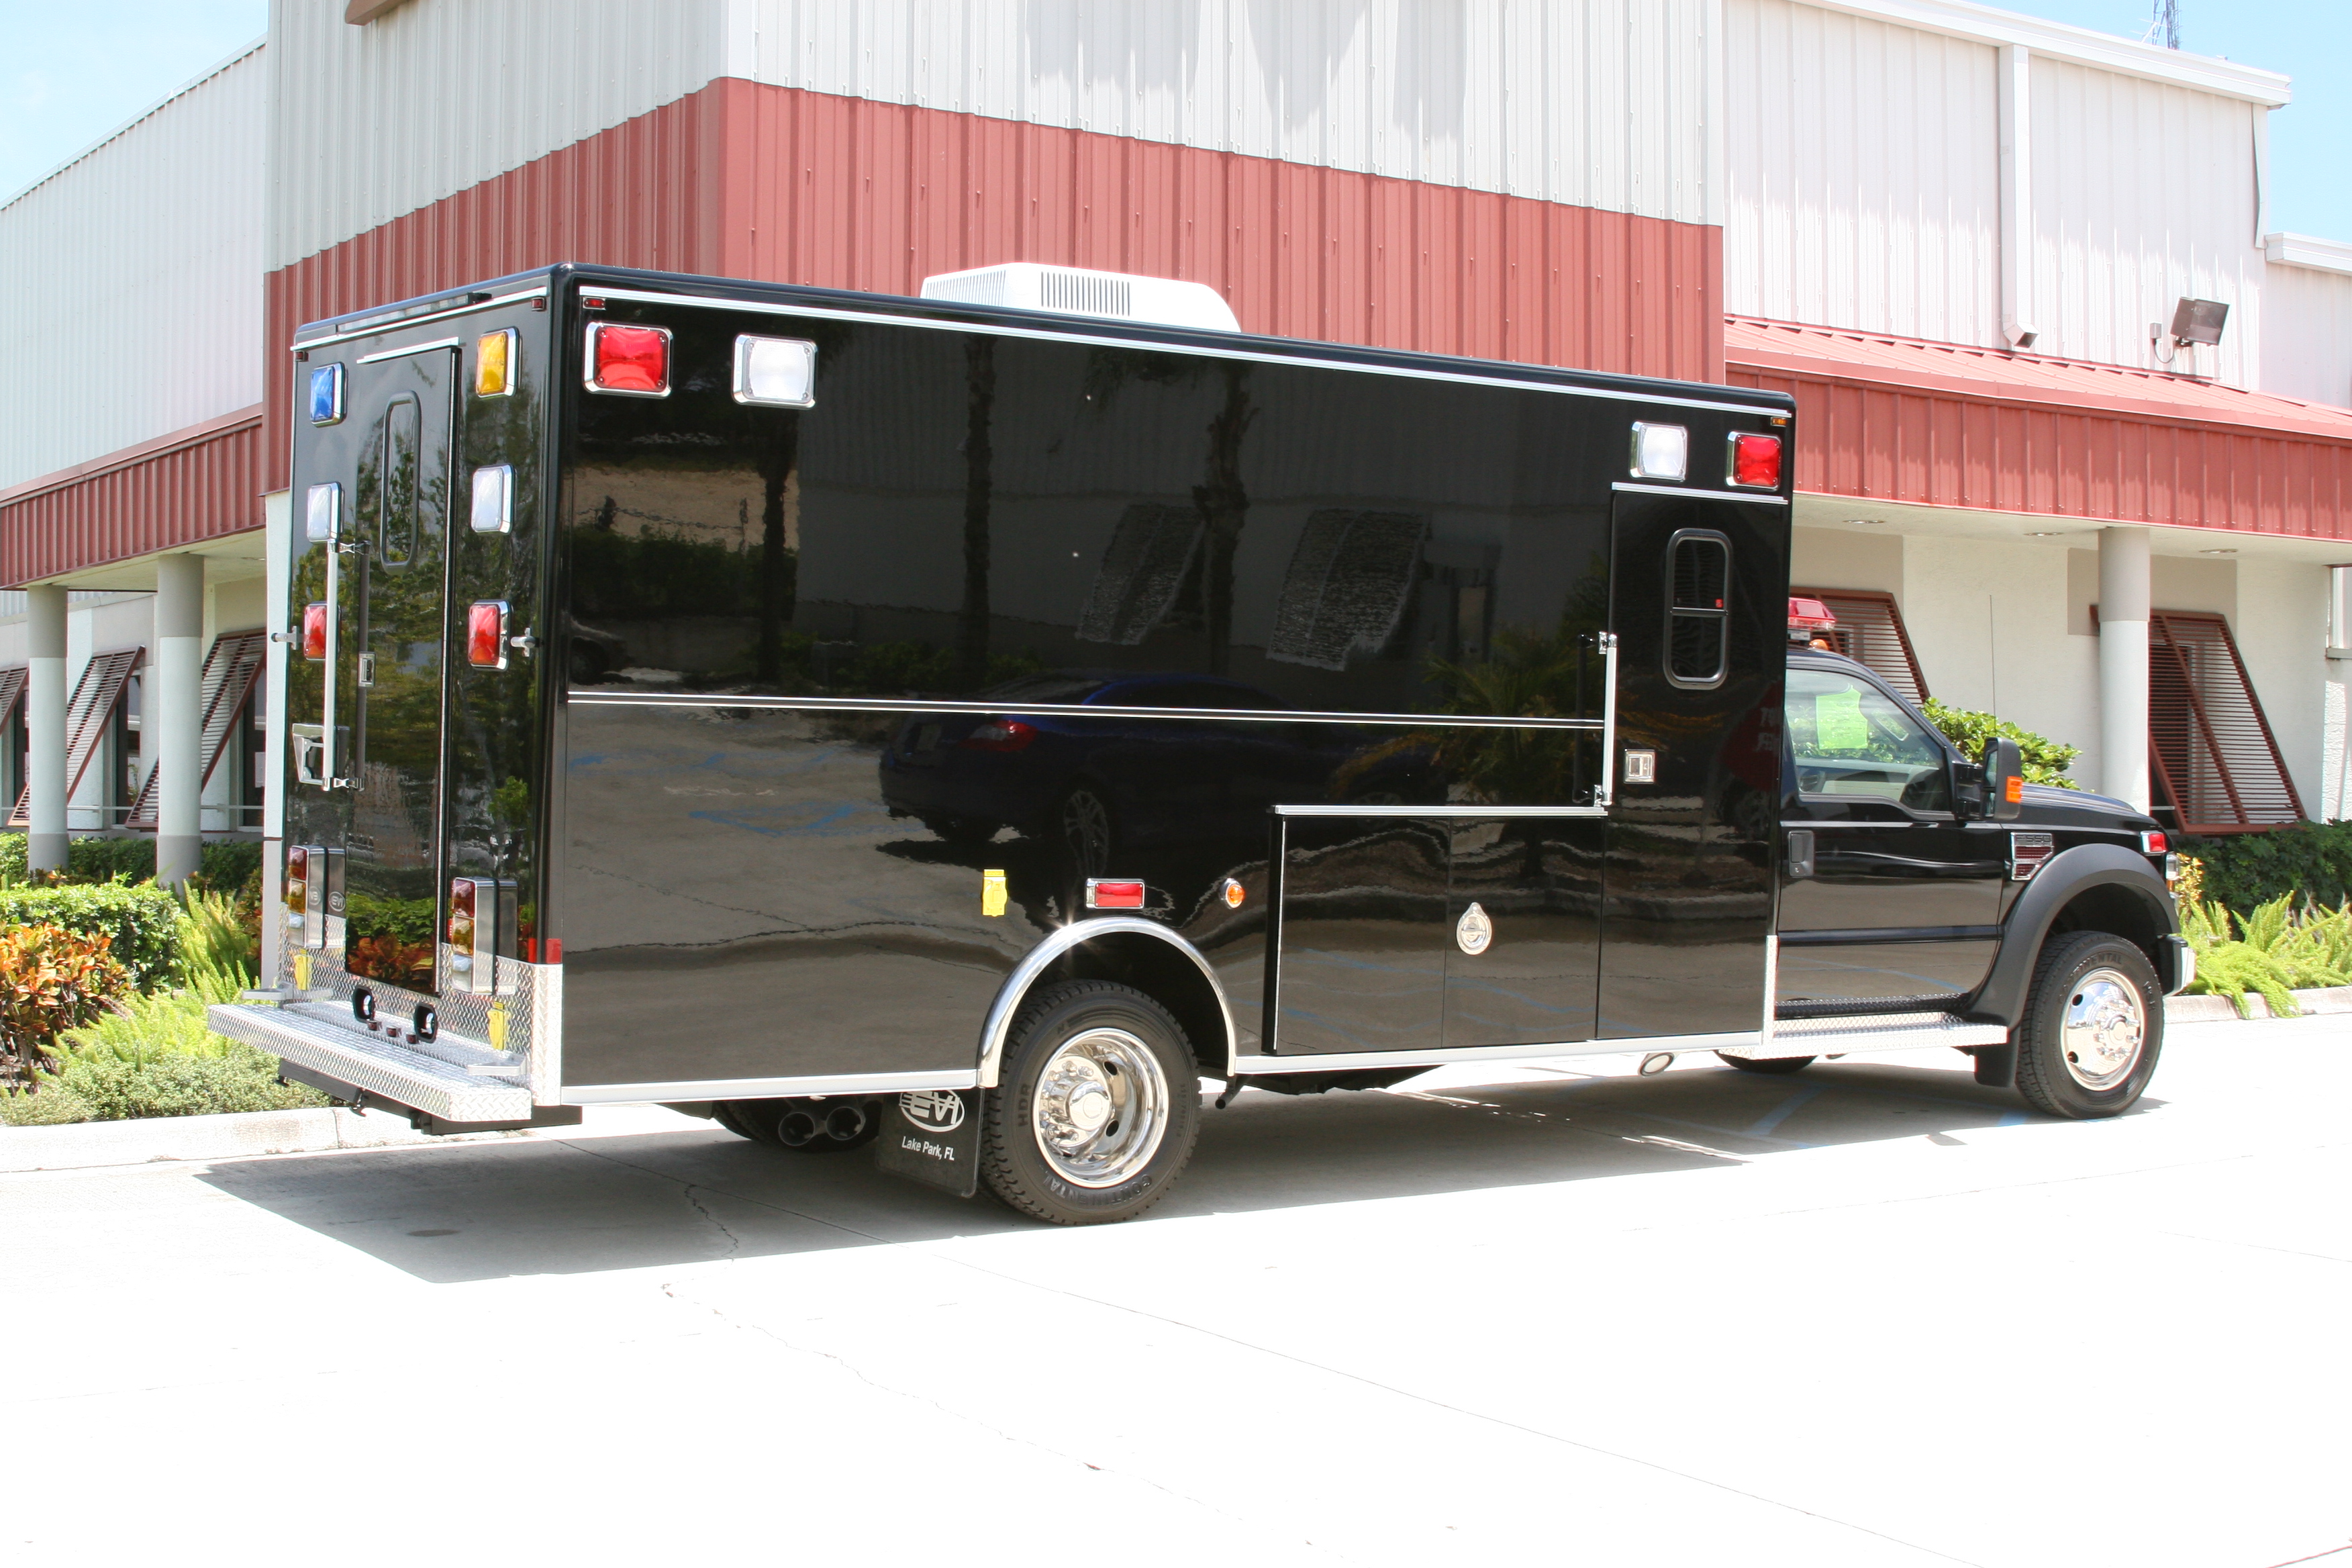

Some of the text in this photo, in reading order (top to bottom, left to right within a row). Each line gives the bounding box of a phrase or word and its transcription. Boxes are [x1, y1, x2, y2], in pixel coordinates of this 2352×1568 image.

[1018, 1083, 1032, 1127] HDR
[901, 1136, 954, 1161] Lake Park, FL
[1042, 1171, 1153, 1205] CONTINENTAL
